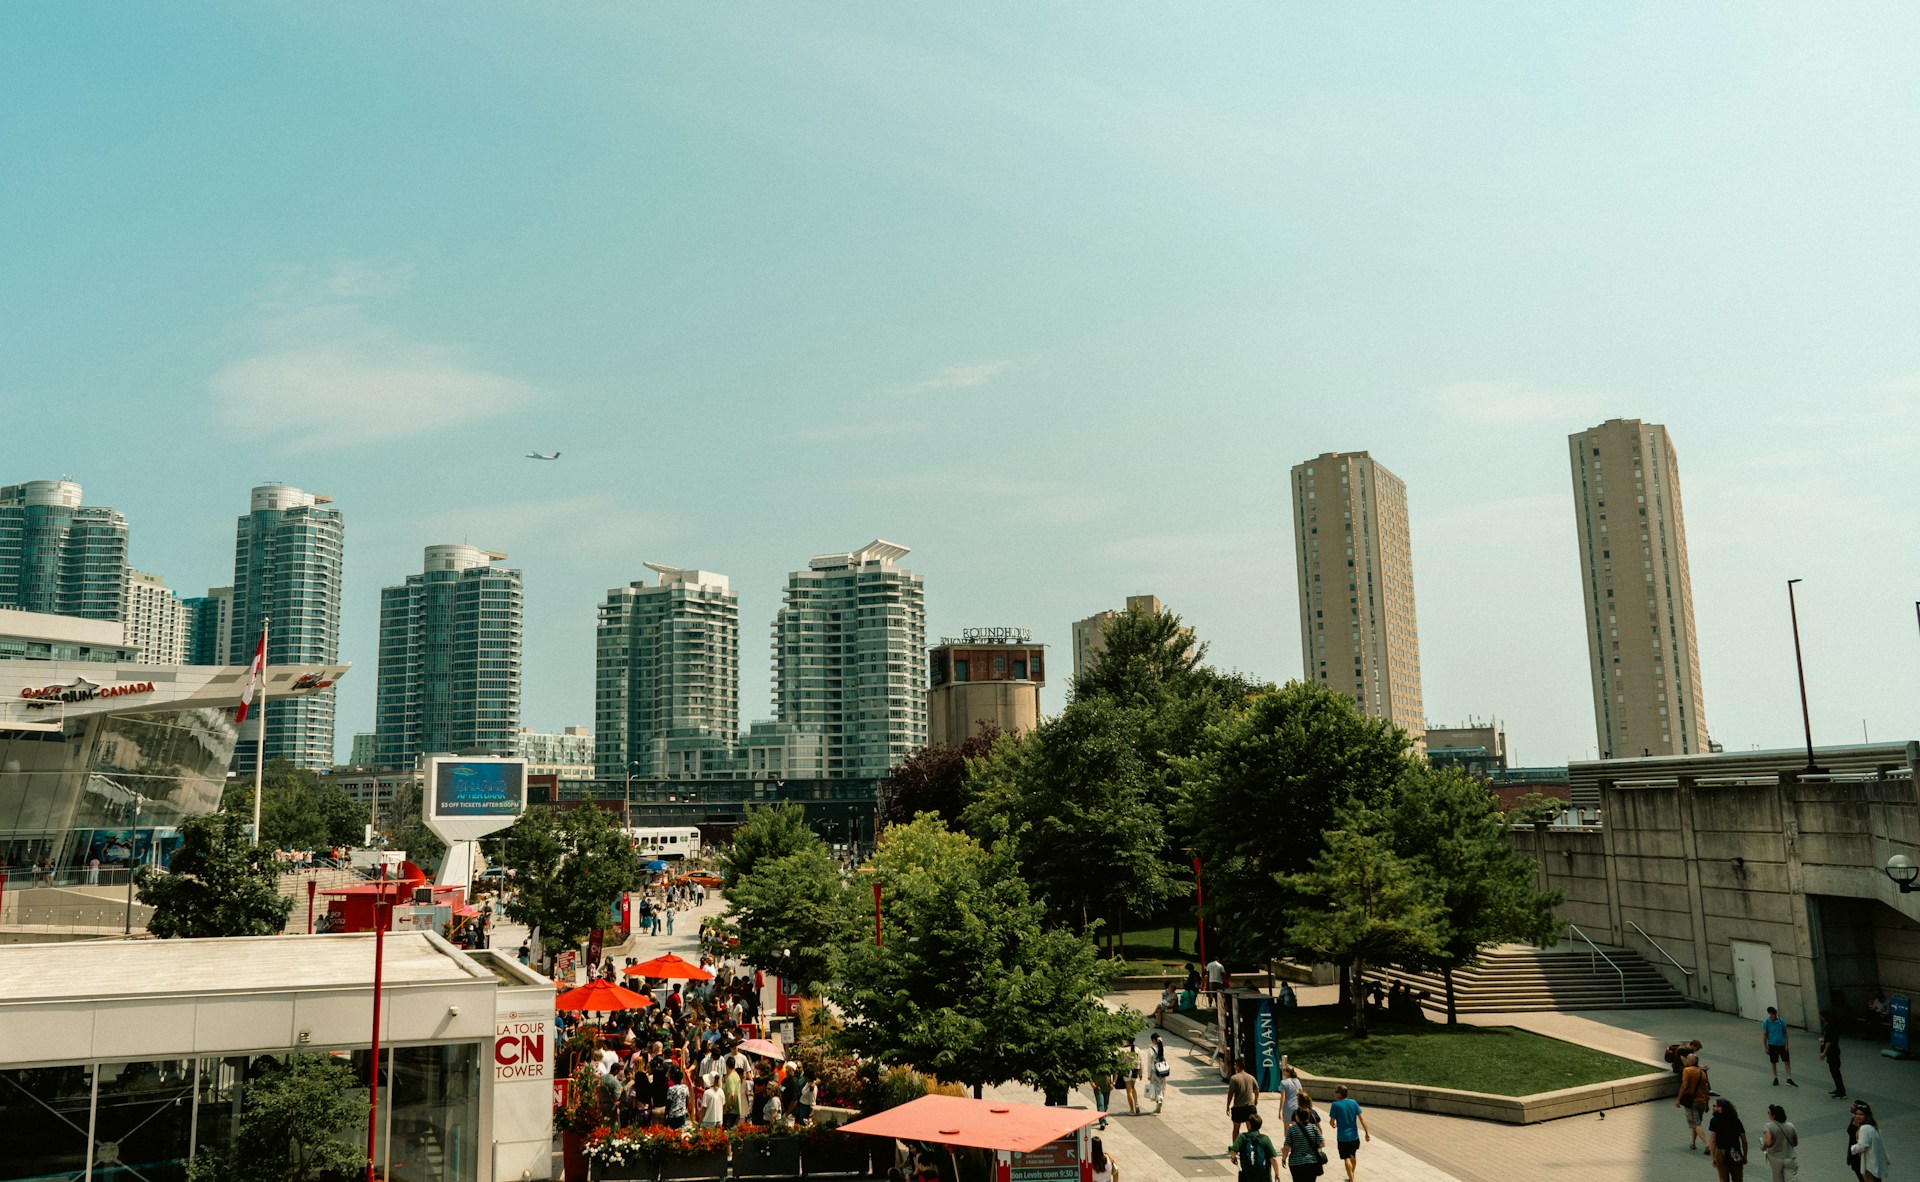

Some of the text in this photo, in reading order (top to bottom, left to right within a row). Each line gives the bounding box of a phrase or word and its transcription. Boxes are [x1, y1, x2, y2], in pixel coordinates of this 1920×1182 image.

[101, 682, 155, 698] CANADA
[496, 1023, 544, 1035] LA TOUR
[1259, 1013, 1275, 1067] DASANI
[495, 1034, 544, 1065] CN
[496, 1064, 544, 1078] TOWER
[1024, 1171, 1042, 1179] Levels
[1043, 1172, 1059, 1180] open
[1060, 1170, 1074, 1178] 9:30
